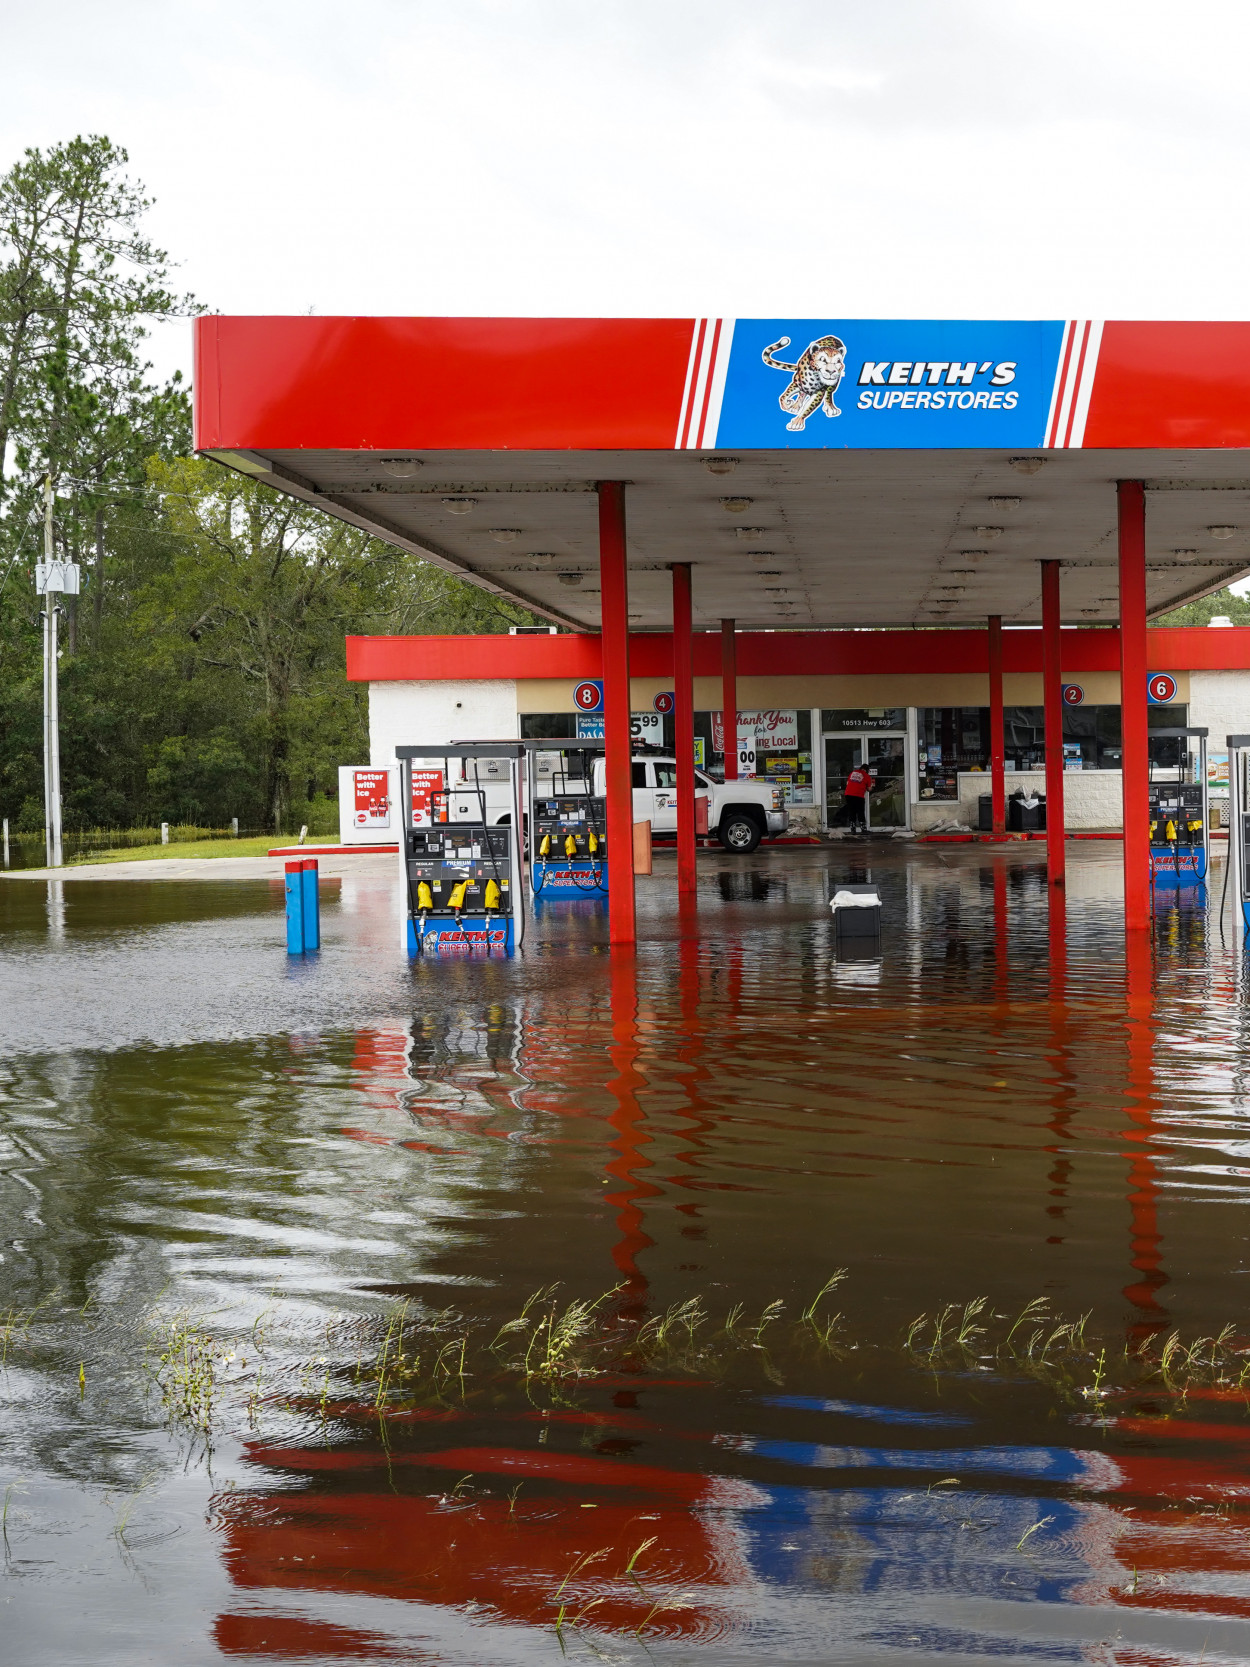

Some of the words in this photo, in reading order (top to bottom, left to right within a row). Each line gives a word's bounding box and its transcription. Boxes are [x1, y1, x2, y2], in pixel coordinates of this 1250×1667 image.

[857, 361, 1018, 386] KEITH'S
[857, 391, 1018, 410] SUPERSTORES
[1069, 690, 1077, 700] 2
[1157, 681, 1167, 696] 6
[582, 689, 592, 704] 8
[658, 698, 666, 708] 4
[737, 711, 763, 725] hank
[763, 711, 793, 730] You
[772, 735, 796, 746] Local
[554, 870, 602, 878] KEITH'S
[438, 930, 505, 942] KEITH'S
